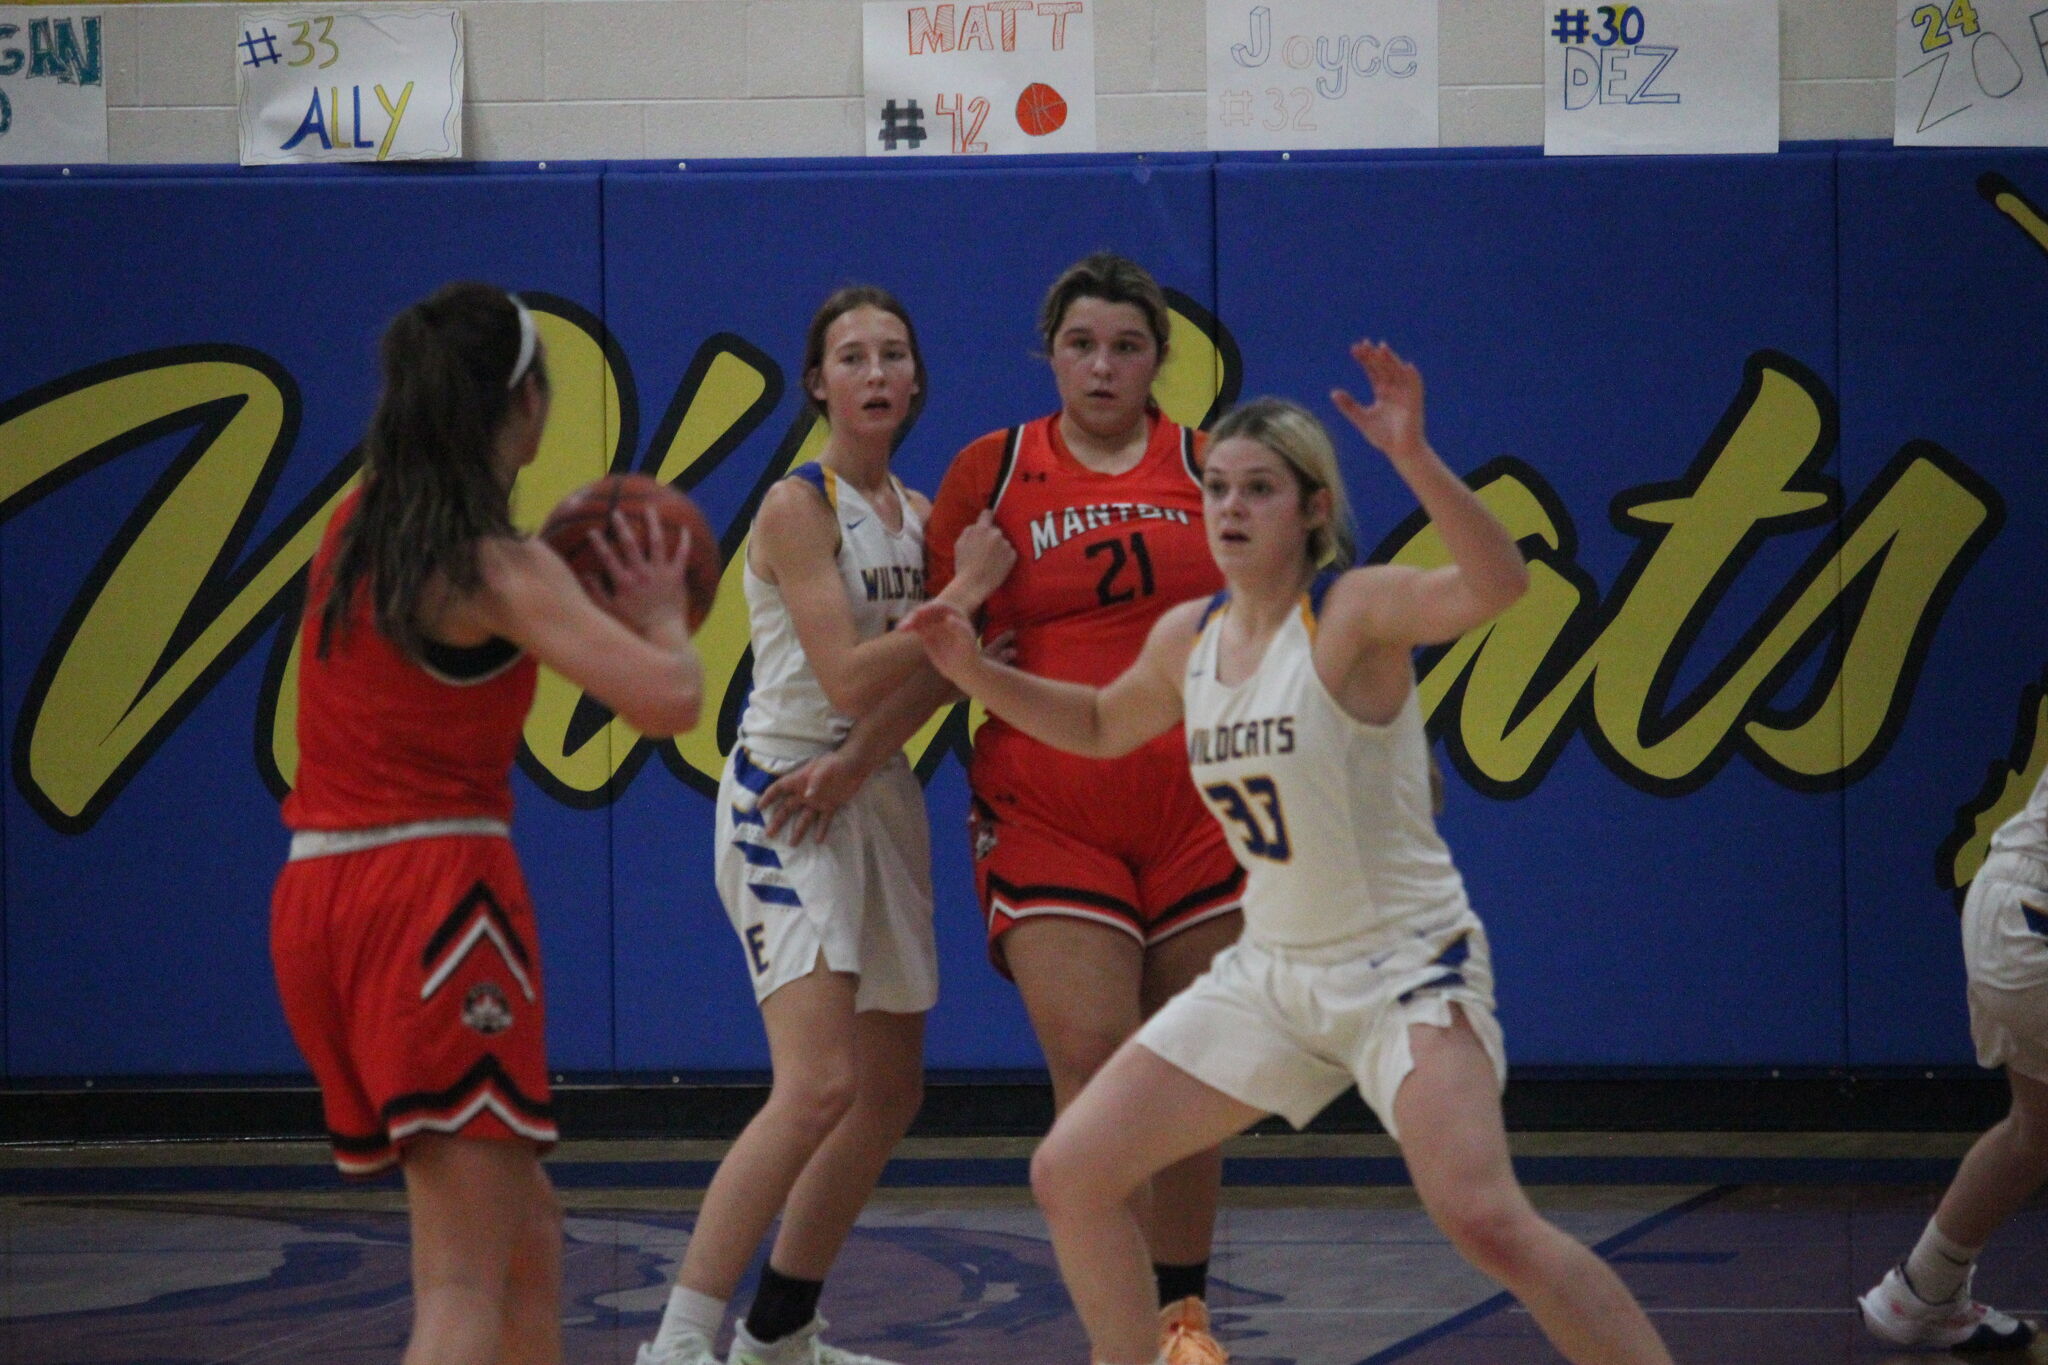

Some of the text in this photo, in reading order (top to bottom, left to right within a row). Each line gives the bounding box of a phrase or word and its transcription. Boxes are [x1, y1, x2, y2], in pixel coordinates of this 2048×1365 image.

[238, 16, 340, 69] #33
[907, 2, 1083, 55] MATT
[1230, 6, 1418, 98] Joyce
[1551, 5, 1645, 47] #30
[1912, 0, 1980, 53] 24
[1564, 45, 1681, 110] DEZ
[280, 81, 415, 160] ALLY
[880, 93, 991, 154] #42
[1219, 87, 1318, 131] #32
[1085, 532, 1155, 605] 21
[745, 922, 770, 977] E
